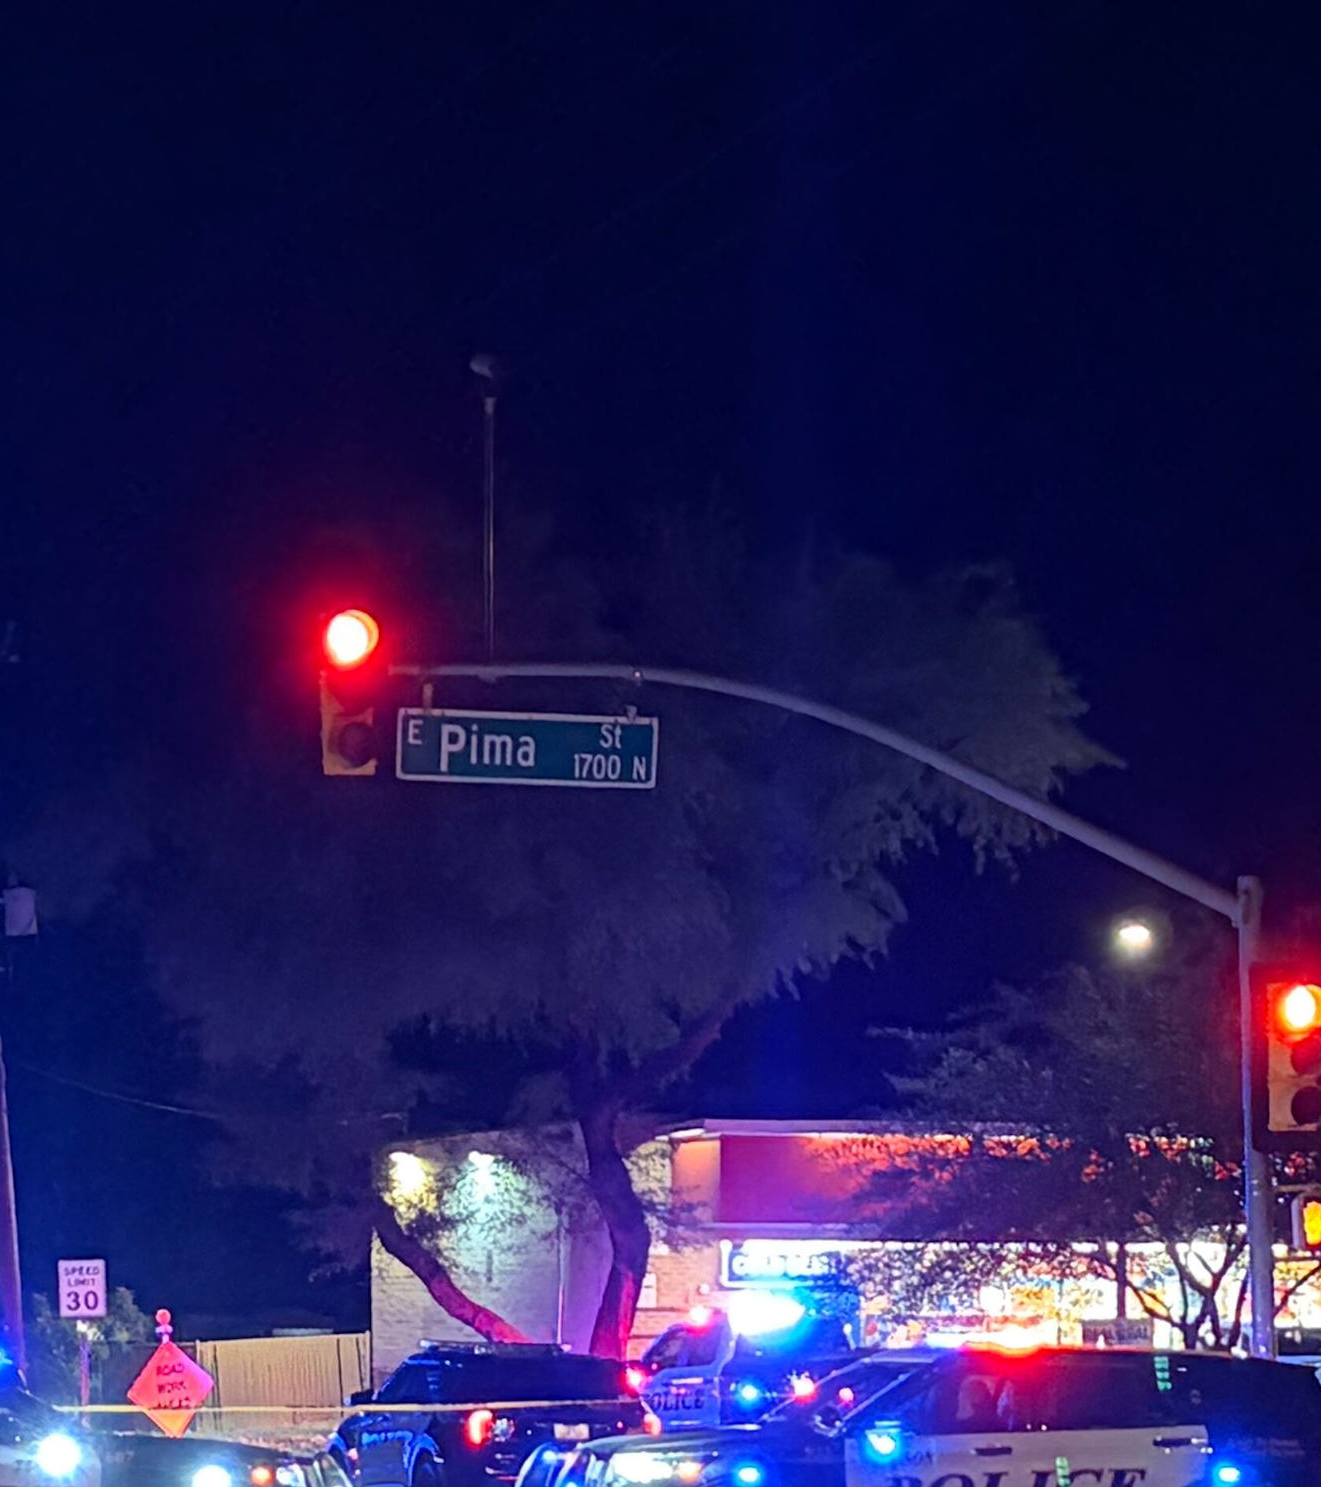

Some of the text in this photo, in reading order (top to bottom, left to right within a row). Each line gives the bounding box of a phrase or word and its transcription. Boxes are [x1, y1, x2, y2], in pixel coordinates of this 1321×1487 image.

[407, 719, 622, 773] E Pima St
[573, 753, 647, 781] 1700 N
[64, 1266, 100, 1276] SPEED
[68, 1278, 95, 1287] LIMIT
[66, 1290, 99, 1311] 30
